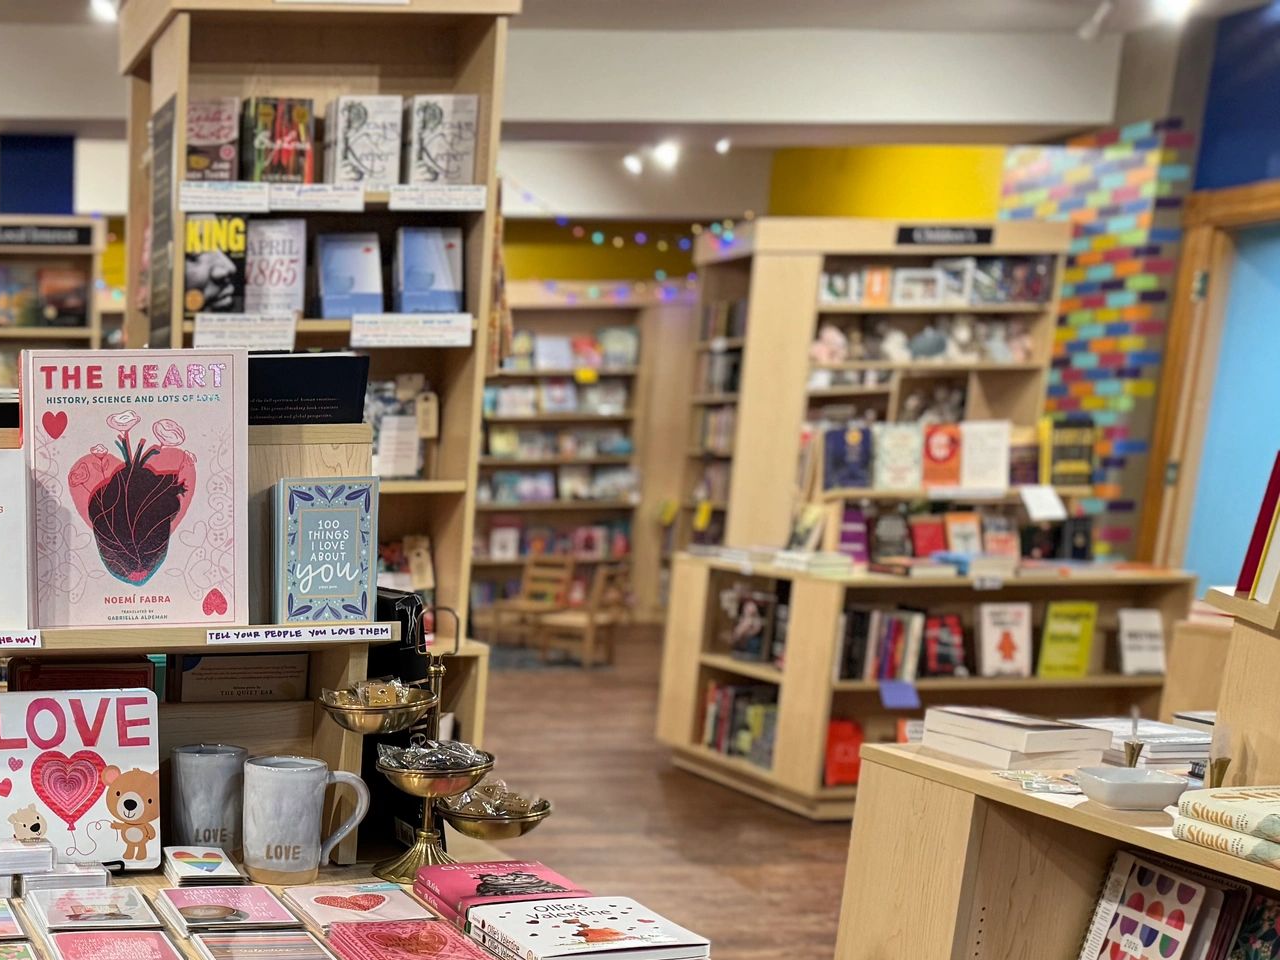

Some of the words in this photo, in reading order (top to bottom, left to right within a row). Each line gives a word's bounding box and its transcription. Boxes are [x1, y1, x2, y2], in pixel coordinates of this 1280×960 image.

[186, 217, 246, 254] KING
[246, 239, 300, 257] APRIL
[244, 258, 300, 288] 1865
[40, 365, 103, 390] THE
[118, 363, 227, 389] HEART
[46, 397, 89, 405] HISTORY,
[92, 396, 132, 404] SCIENCE
[157, 395, 180, 403] LOTS
[182, 394, 193, 402] OF
[196, 393, 220, 402] LOVE
[317, 519, 340, 530] 100
[308, 529, 350, 540] THINGS
[319, 540, 346, 551] LOVE
[310, 552, 347, 562] ABOUT
[296, 562, 360, 594] you
[104, 593, 136, 605] NOEMÍ
[139, 594, 171, 604] FABRA
[208, 632, 231, 640] TELL
[233, 631, 261, 640] YOUR
[264, 630, 302, 639] PEOPLE
[308, 628, 328, 638] YOU
[331, 628, 356, 636] LOVE
[359, 626, 389, 636] THEM
[15, 635, 37, 646] WAY
[1191, 801, 1233, 829] Strata
[194, 828, 228, 843] LOVE
[1186, 824, 1229, 852] Strata
[264, 844, 301, 860] LOVE
[526, 908, 613, 921] Valentine
[533, 903, 588, 912] Ollie's
